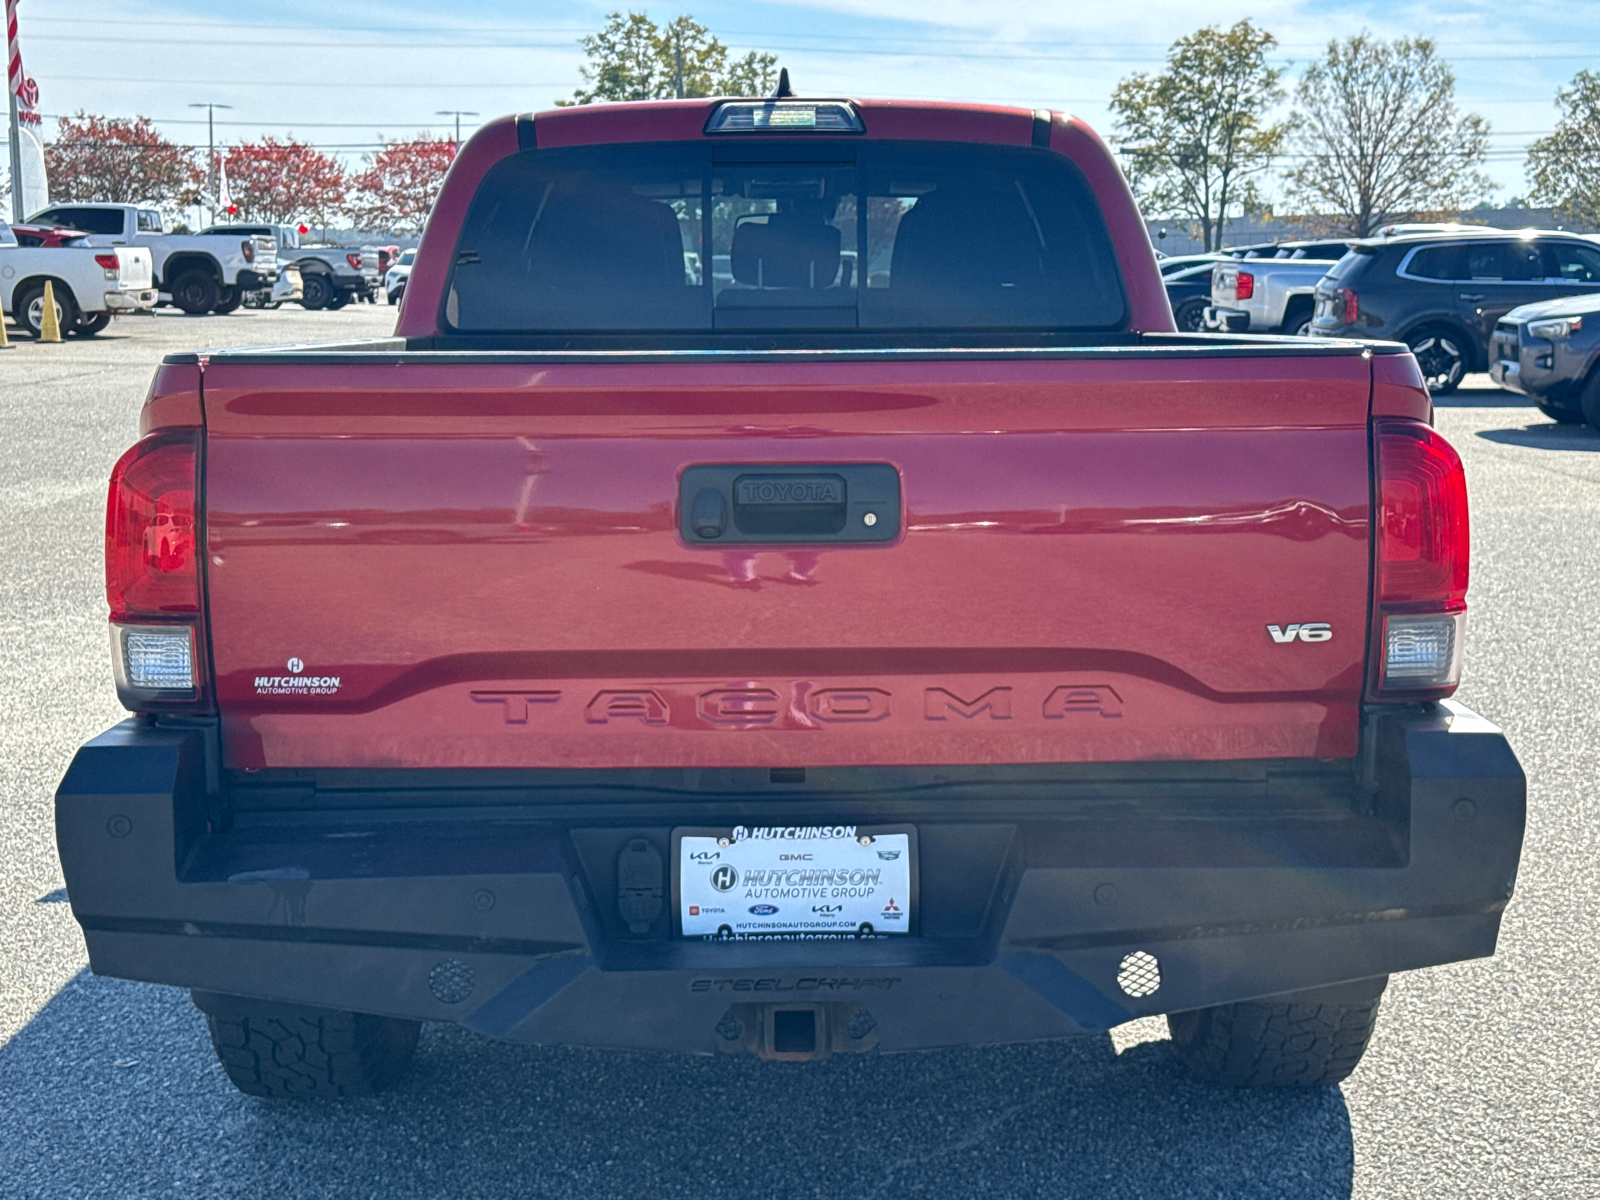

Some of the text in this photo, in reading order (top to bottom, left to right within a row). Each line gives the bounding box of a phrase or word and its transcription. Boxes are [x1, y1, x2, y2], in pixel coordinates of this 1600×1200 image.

[743, 482, 836, 500] TOYOTA
[1266, 622, 1333, 643] V6
[254, 676, 340, 687] HUTCHINSON
[470, 684, 1124, 724] TACOMA
[752, 826, 856, 839] HUTCHINSON
[743, 869, 881, 886] HUTCHINSON
[745, 887, 874, 898] AUTOMOTIVE GROUP
[754, 905, 773, 914] Ford
[736, 921, 856, 929] HUTCHINSONAUTOGROUP.COM
[691, 978, 901, 992] STEELCRAFT
